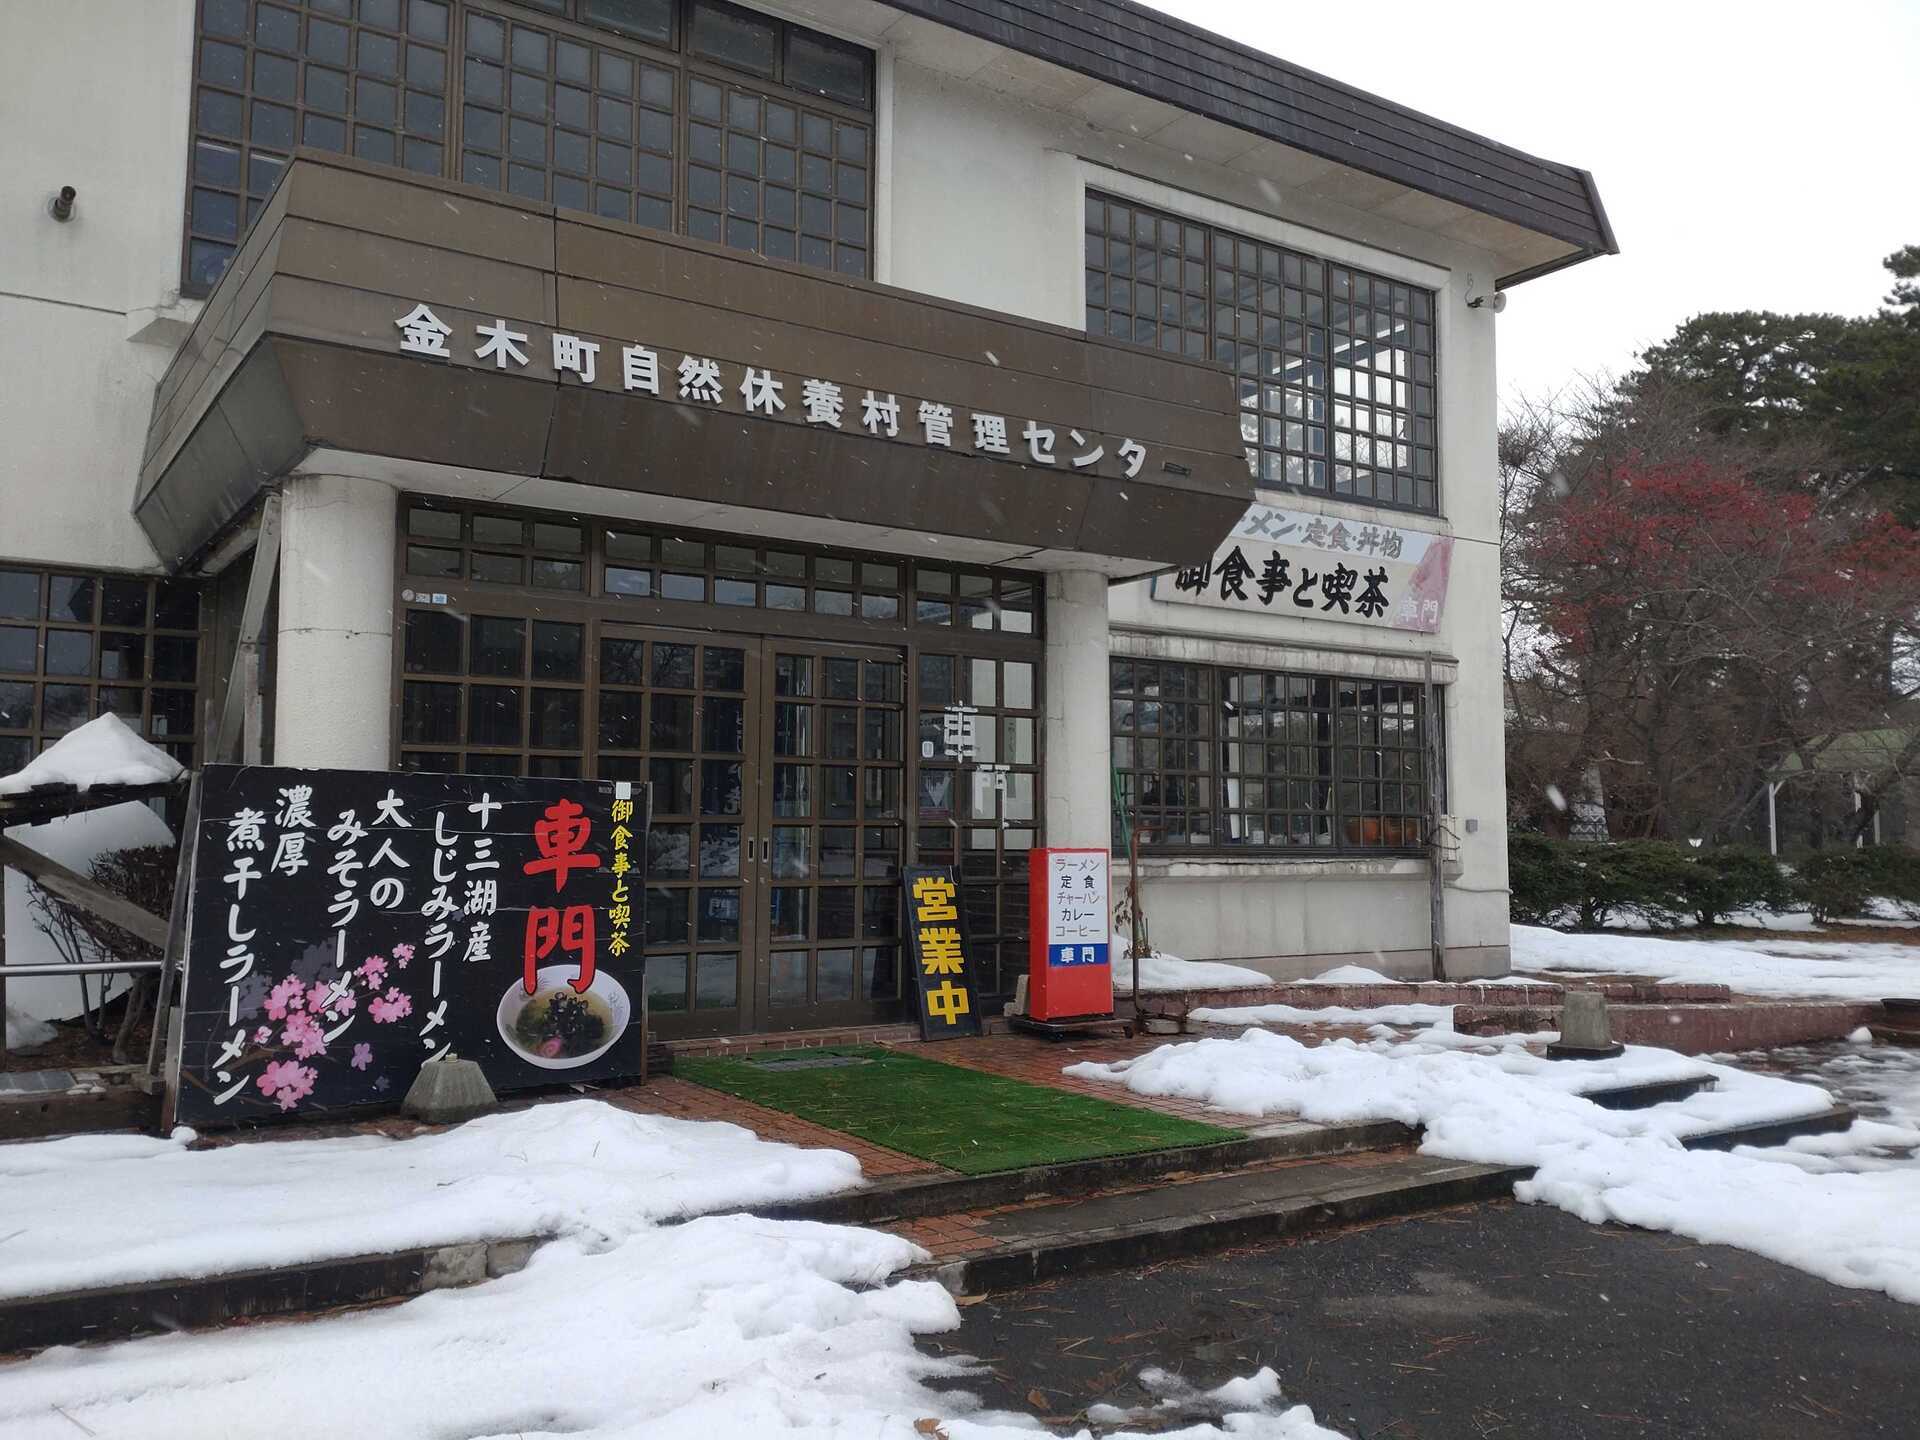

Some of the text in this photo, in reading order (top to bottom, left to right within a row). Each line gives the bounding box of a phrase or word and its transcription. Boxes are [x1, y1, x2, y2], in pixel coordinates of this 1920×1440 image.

[394, 302, 1147, 479] 金木町自然休養村管理センタ
[1240, 510, 1403, 559] メン・定食・丼物
[271, 784, 317, 877] 濃厚
[367, 788, 412, 909] 大人の
[462, 793, 502, 962] 十三湖産
[522, 798, 601, 995] 車門
[608, 799, 634, 957] 御食事と喫茶
[1055, 859, 1100, 872] ラーメン
[212, 807, 267, 1106] 煮干しラーメン
[321, 808, 369, 1043] みそラーメン
[418, 811, 460, 1069] しじみラーメン
[912, 876, 971, 1026] 営業中
[1055, 925, 1101, 937] コーヒー
[1061, 908, 1095, 922] カレー
